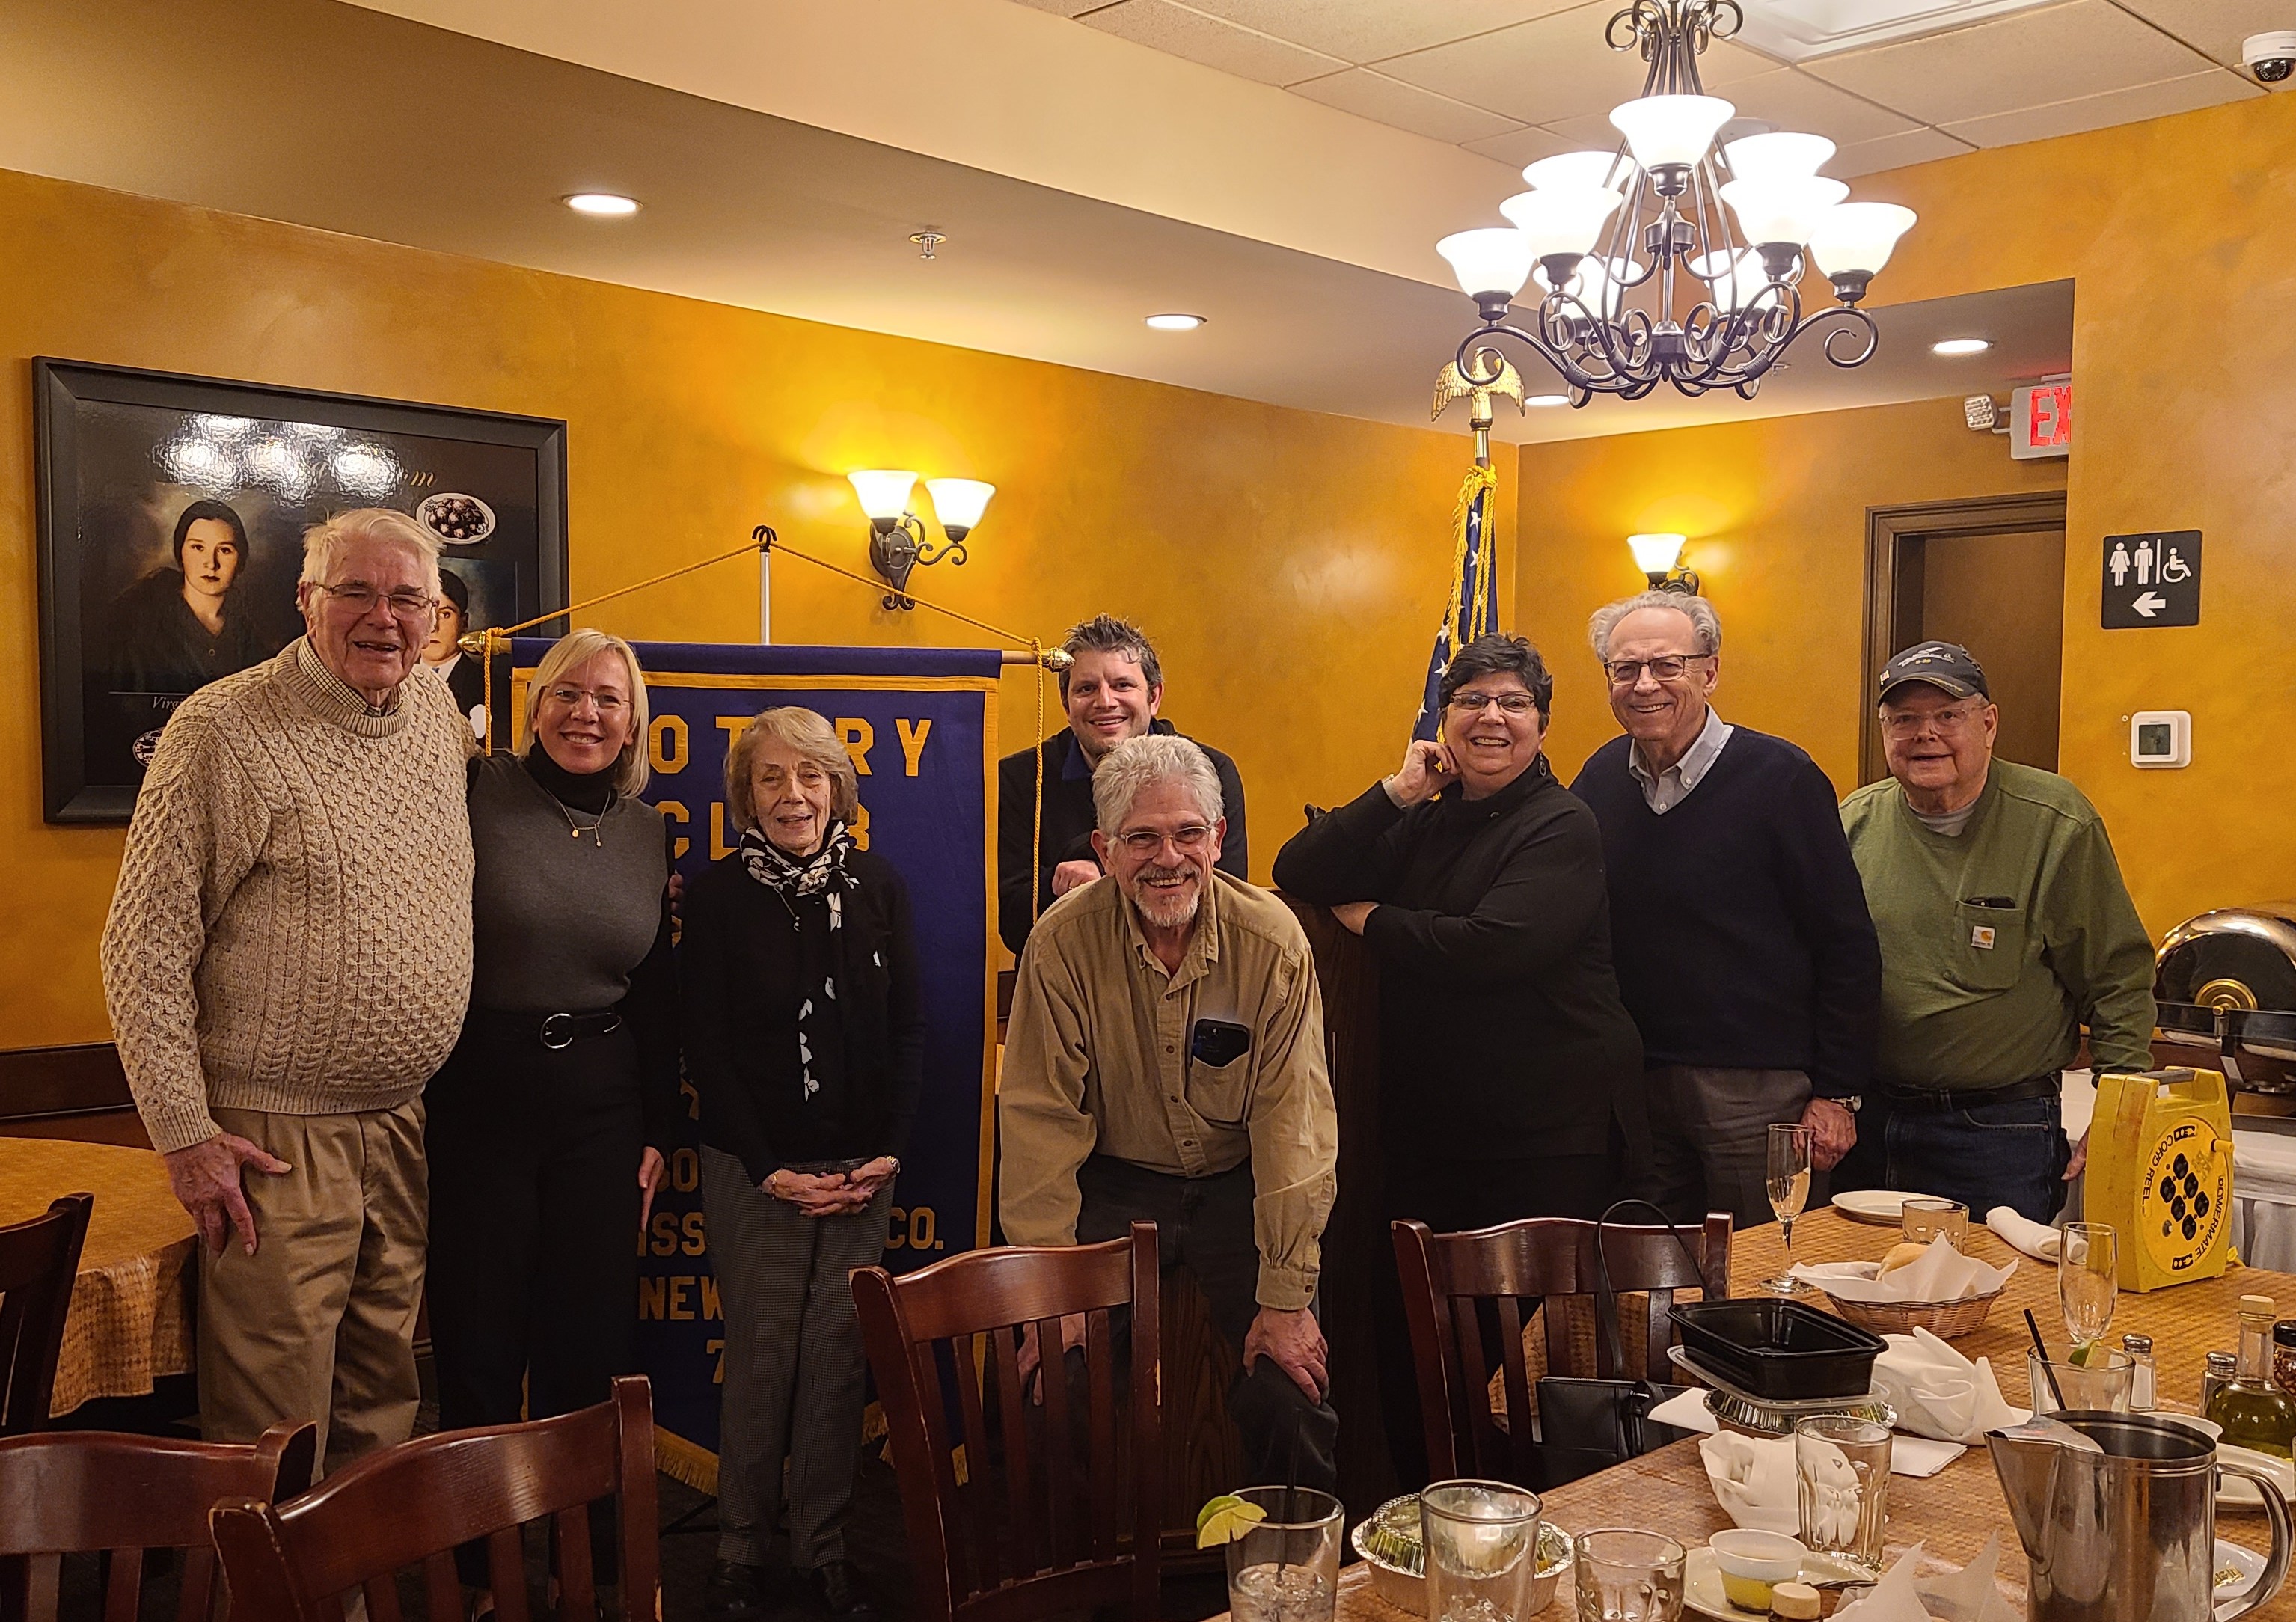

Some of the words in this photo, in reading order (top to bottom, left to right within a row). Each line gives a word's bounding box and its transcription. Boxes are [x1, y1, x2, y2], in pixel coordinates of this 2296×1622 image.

[153, 696, 183, 713] Virg
[2152, 1134, 2173, 1167] CORD
[2142, 1166, 2155, 1205] REEL
[2194, 1175, 2224, 1258] POWERMATE
